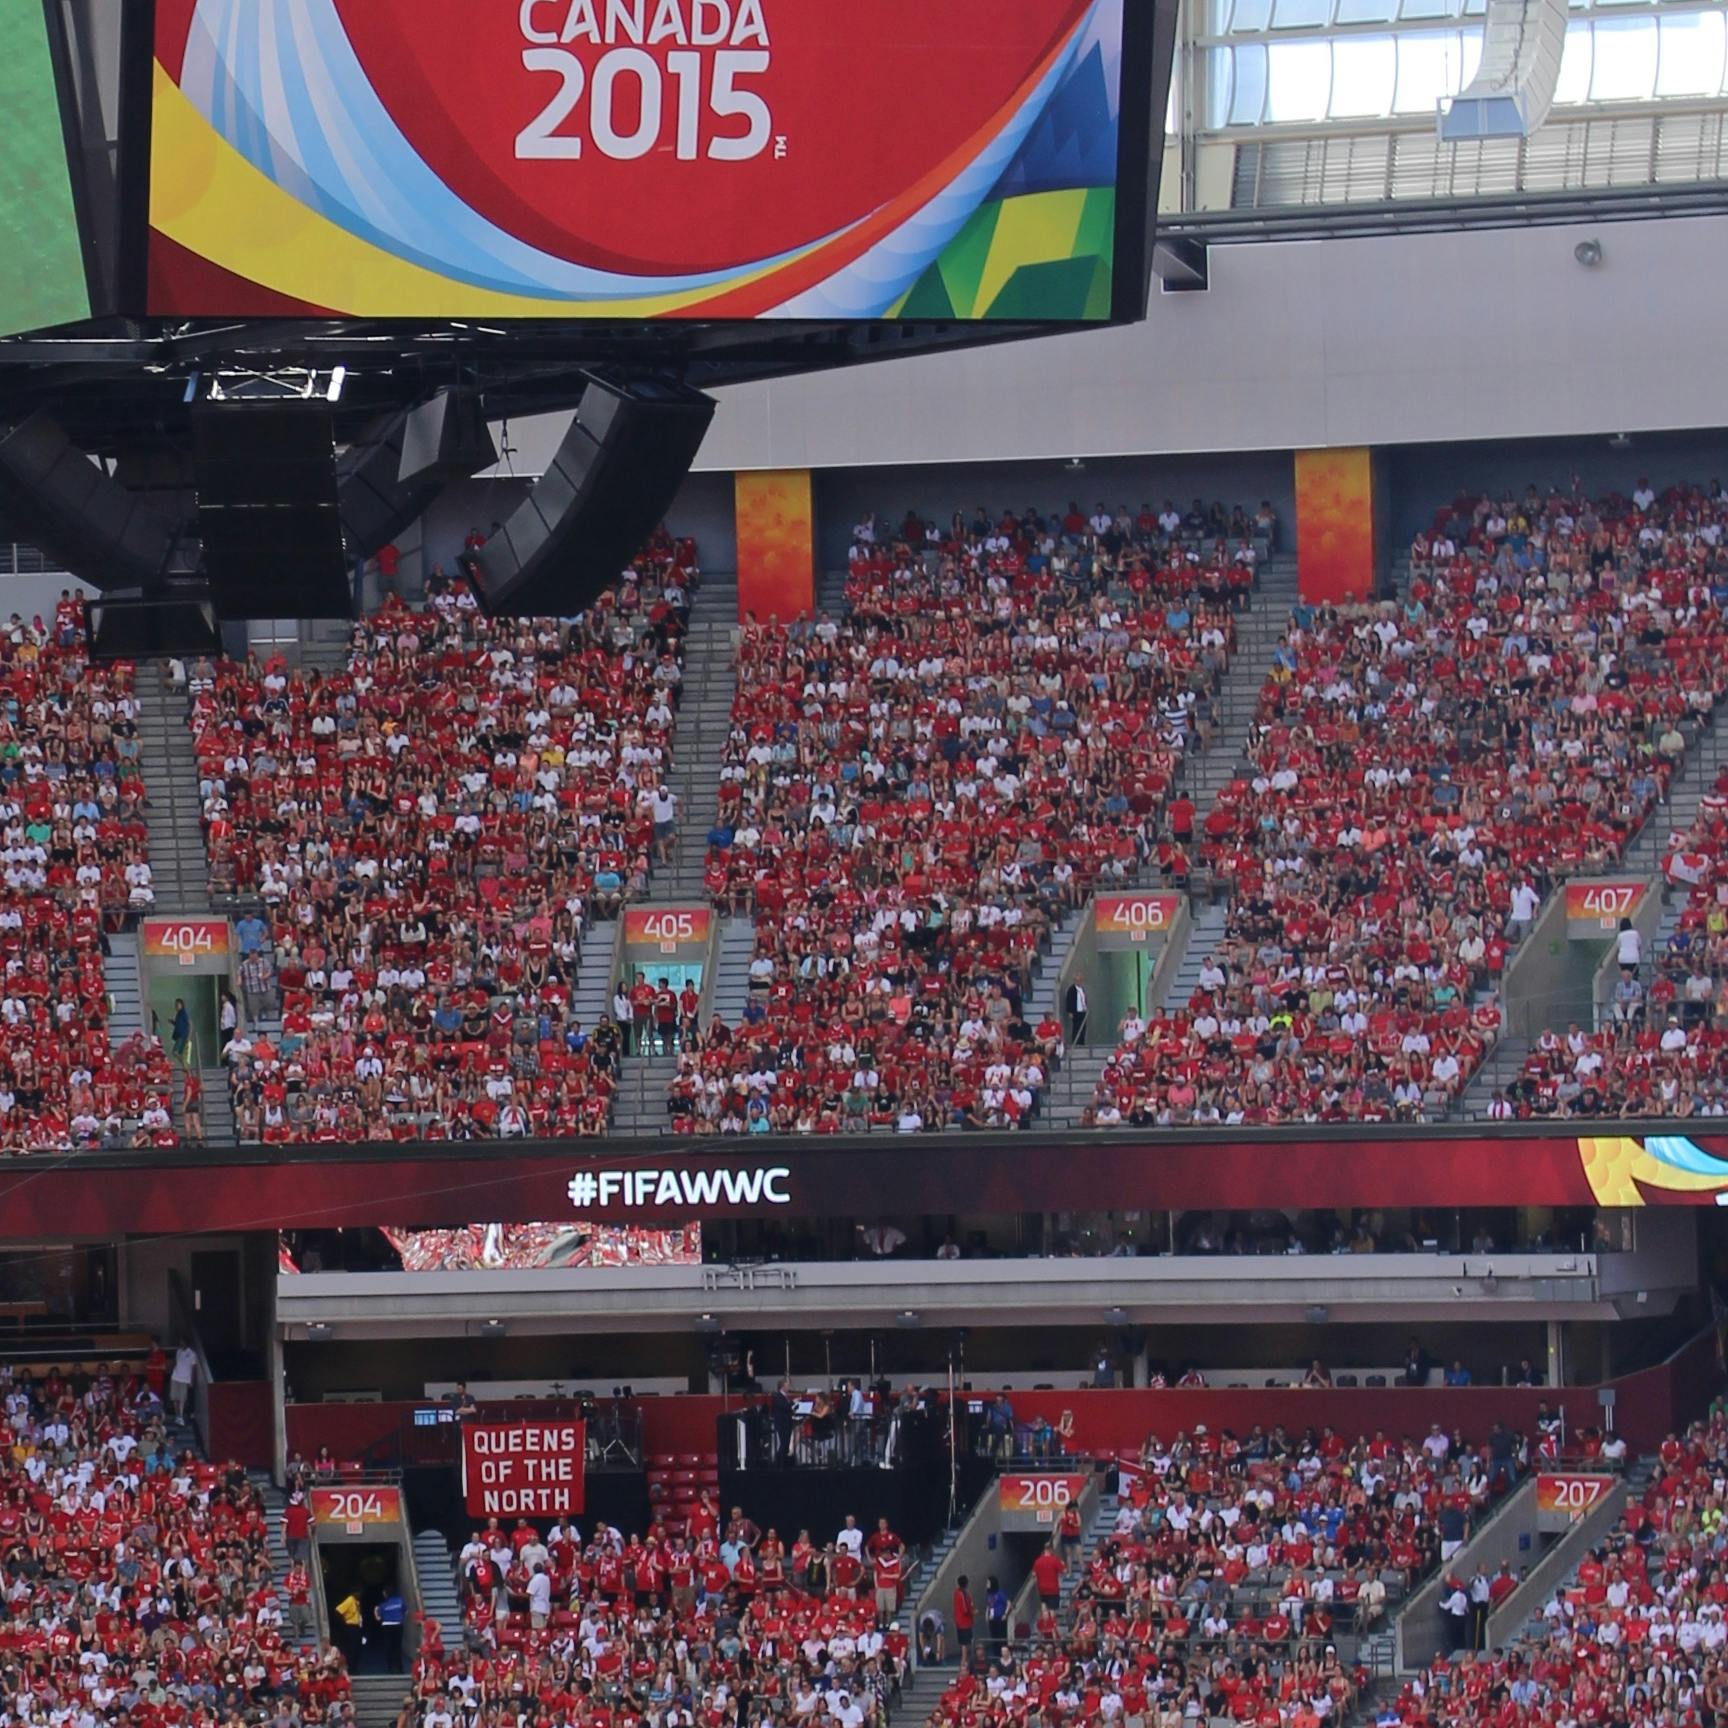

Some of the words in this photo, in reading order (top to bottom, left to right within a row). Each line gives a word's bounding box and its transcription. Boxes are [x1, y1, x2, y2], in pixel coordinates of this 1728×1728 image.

[514, 47, 773, 161] 2015
[1583, 888, 1633, 912] 407
[643, 914, 692, 938] 405
[1113, 902, 1163, 926] 406
[161, 926, 211, 950] 404
[567, 1167, 791, 1207] #FIFAWWC
[473, 1428, 575, 1454] QUEENS
[481, 1459, 513, 1483] OF
[523, 1458, 573, 1482] THE
[484, 1487, 570, 1513] NORTH
[1019, 1480, 1070, 1505] 206
[1553, 1480, 1601, 1506] 207
[329, 1493, 381, 1518] 204
